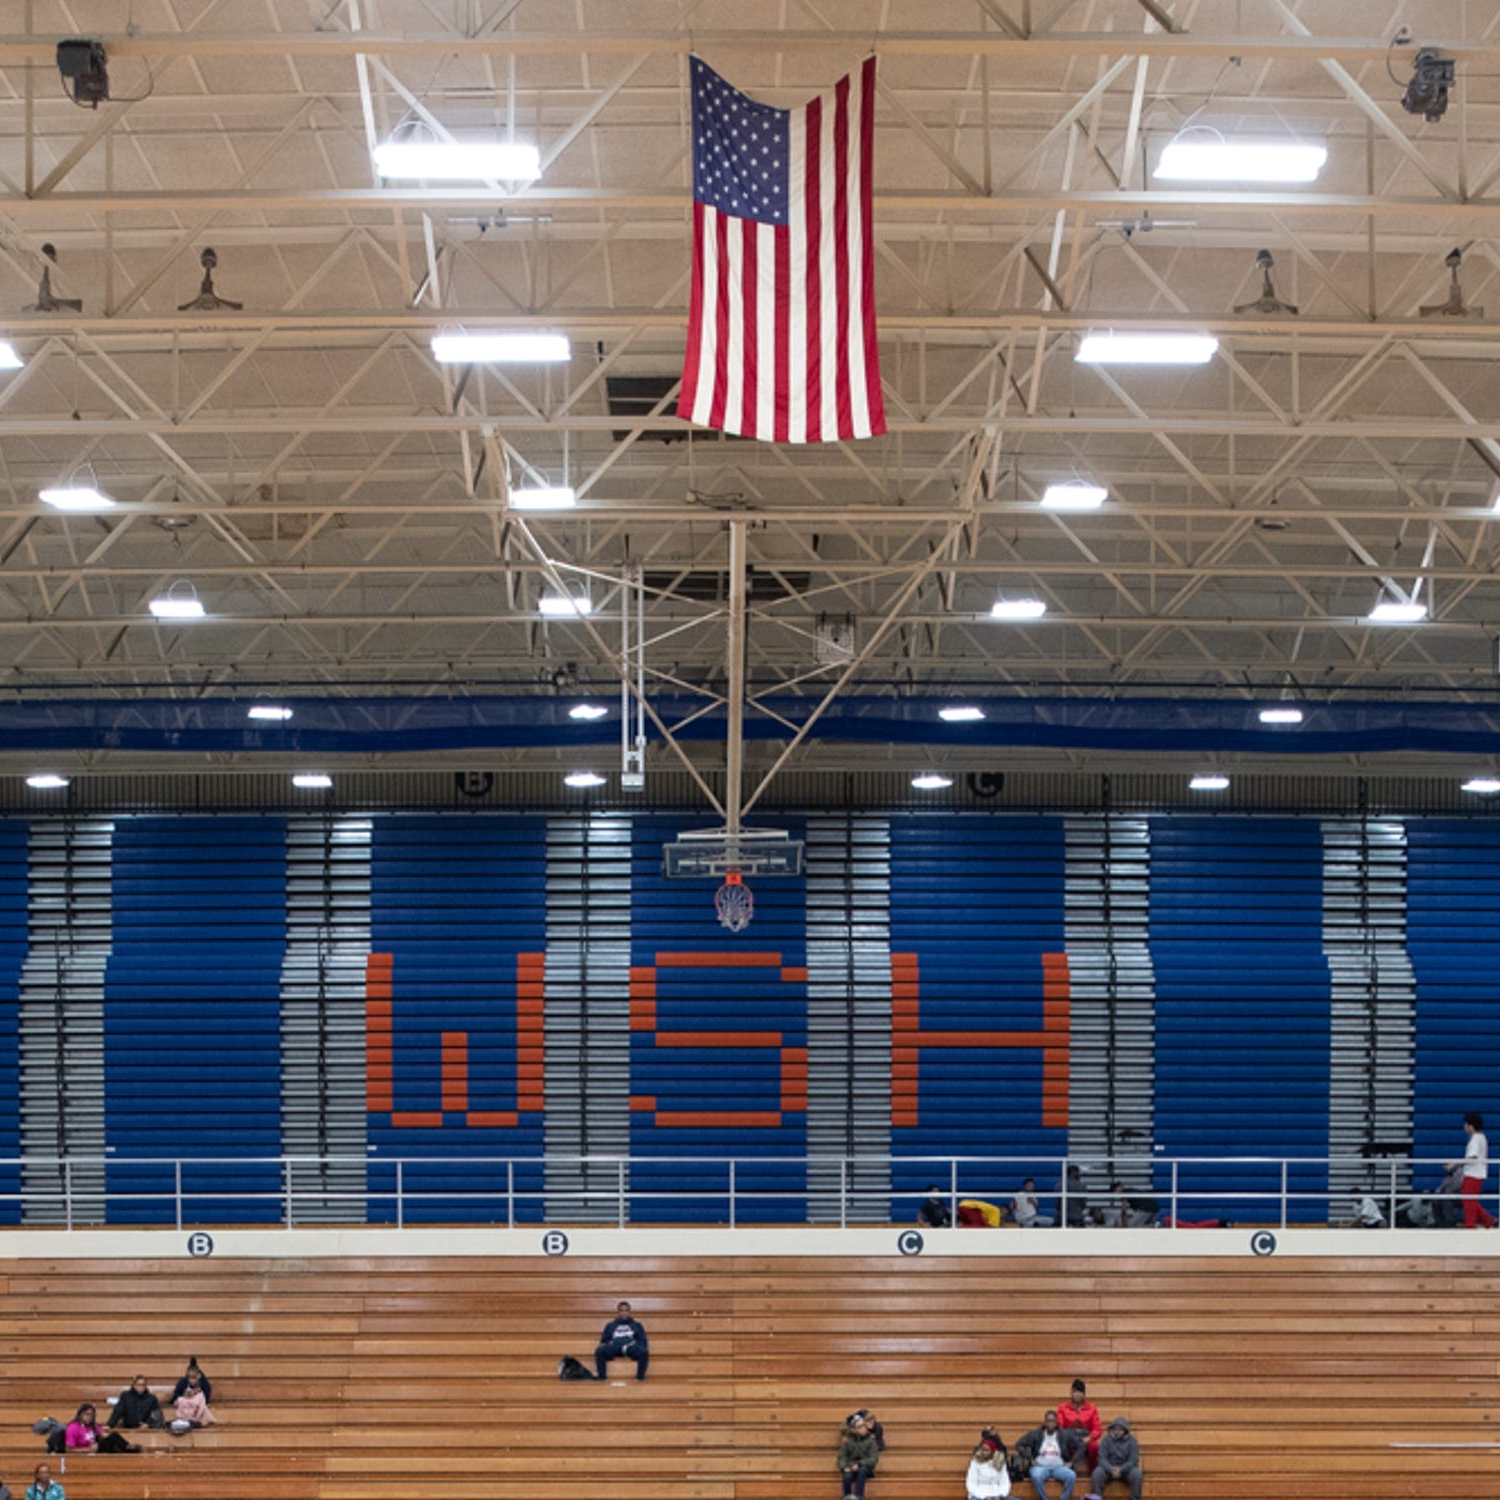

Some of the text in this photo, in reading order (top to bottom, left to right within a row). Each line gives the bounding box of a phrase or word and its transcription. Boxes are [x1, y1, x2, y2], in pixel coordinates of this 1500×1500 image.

[193, 1235, 210, 1254] B
[547, 1234, 565, 1254] B
[901, 1233, 918, 1253] C
[1254, 1233, 1270, 1253] C
